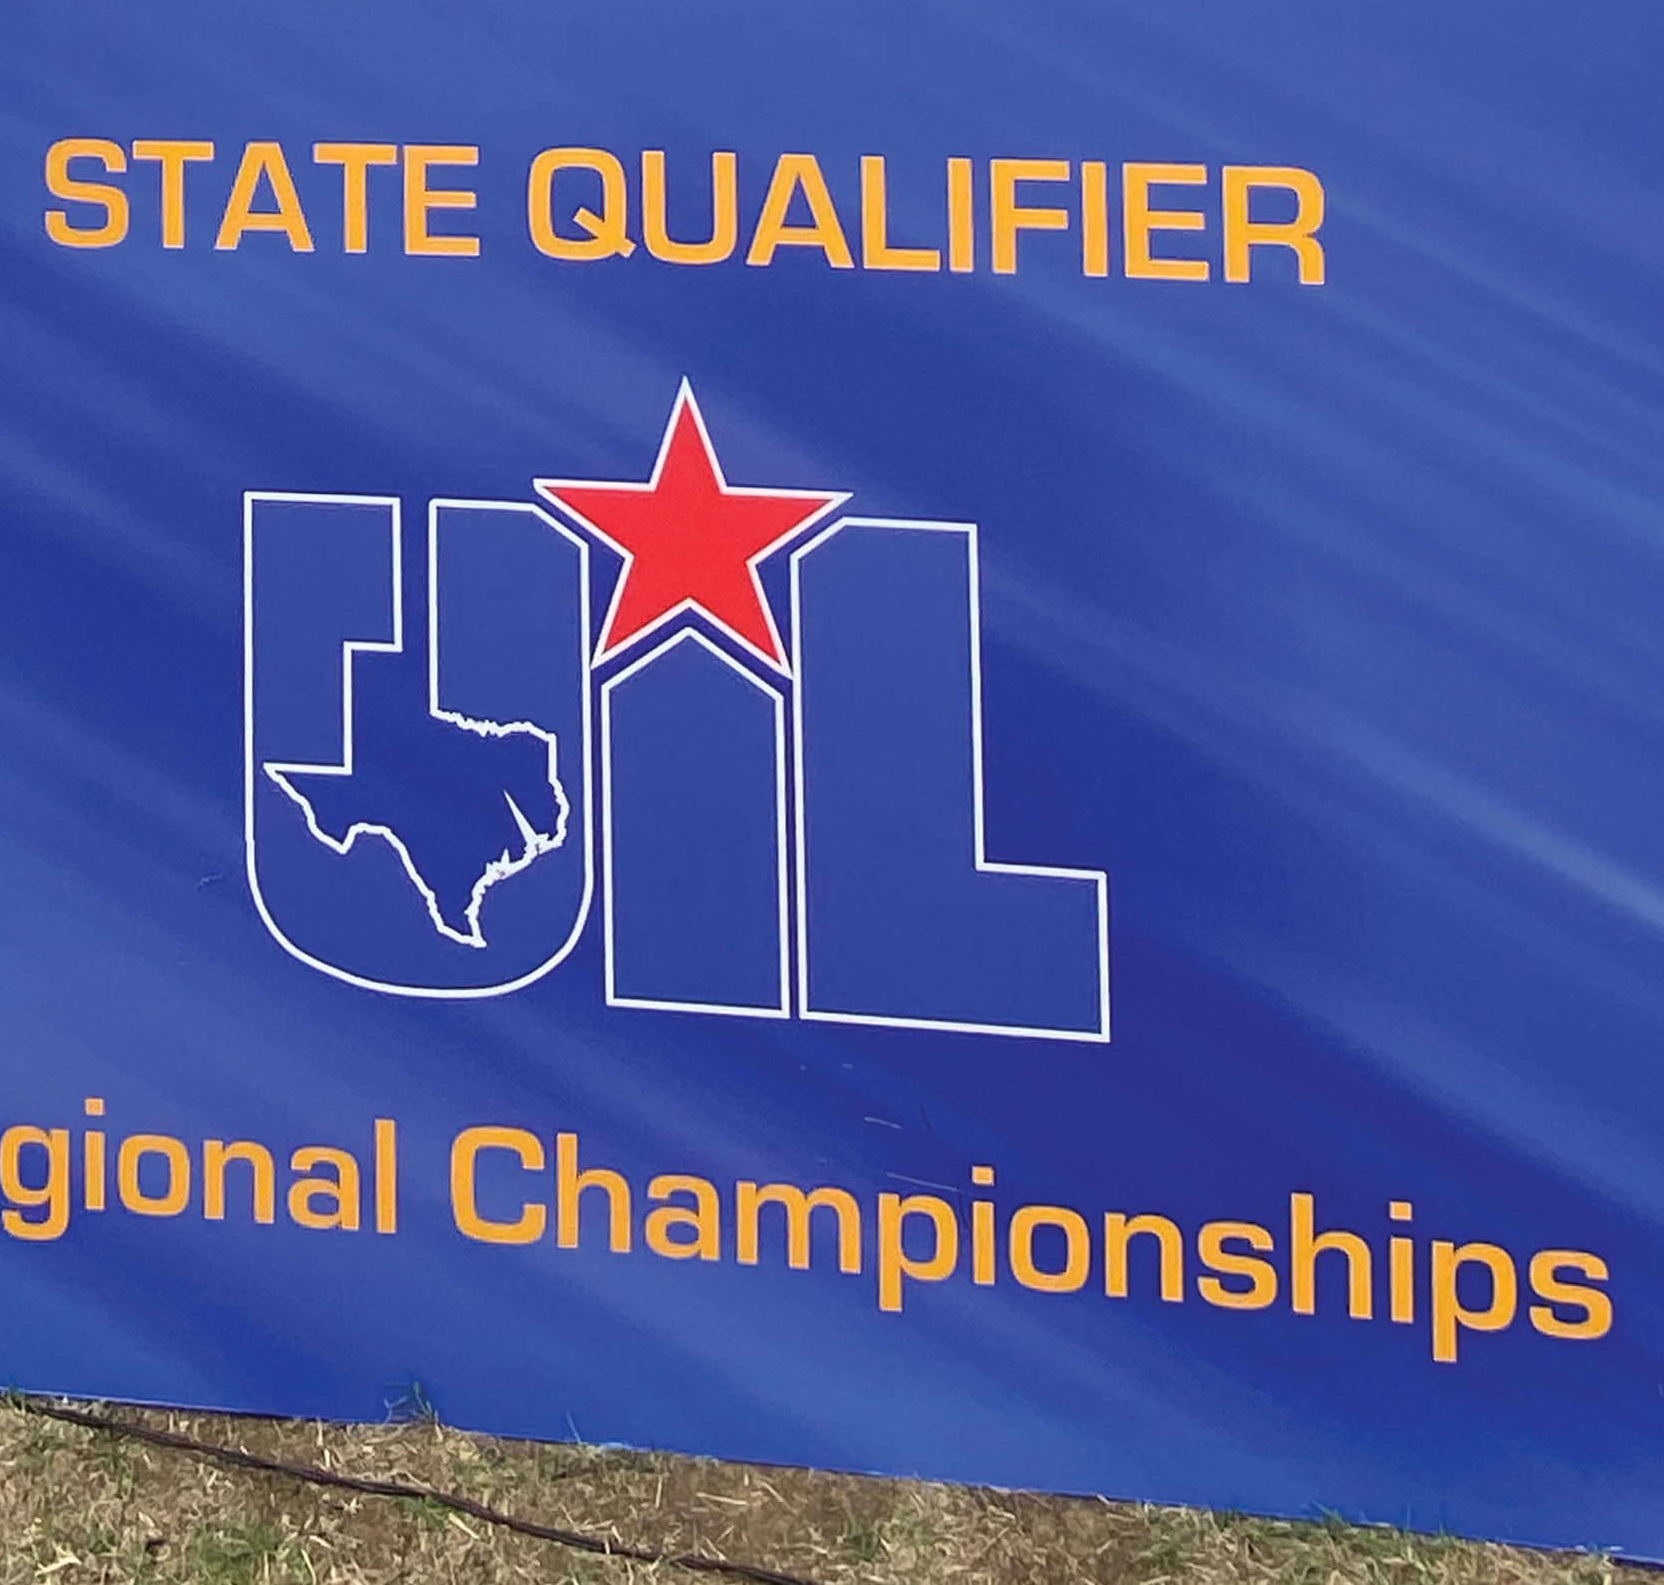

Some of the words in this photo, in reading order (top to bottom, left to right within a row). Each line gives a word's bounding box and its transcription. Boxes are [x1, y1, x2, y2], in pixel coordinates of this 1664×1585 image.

[44, 138, 480, 256] STATE
[528, 147, 1326, 286] QUALIFIER
[243, 488, 1111, 1044] UIL
[450, 1125, 1613, 1363] Championships
